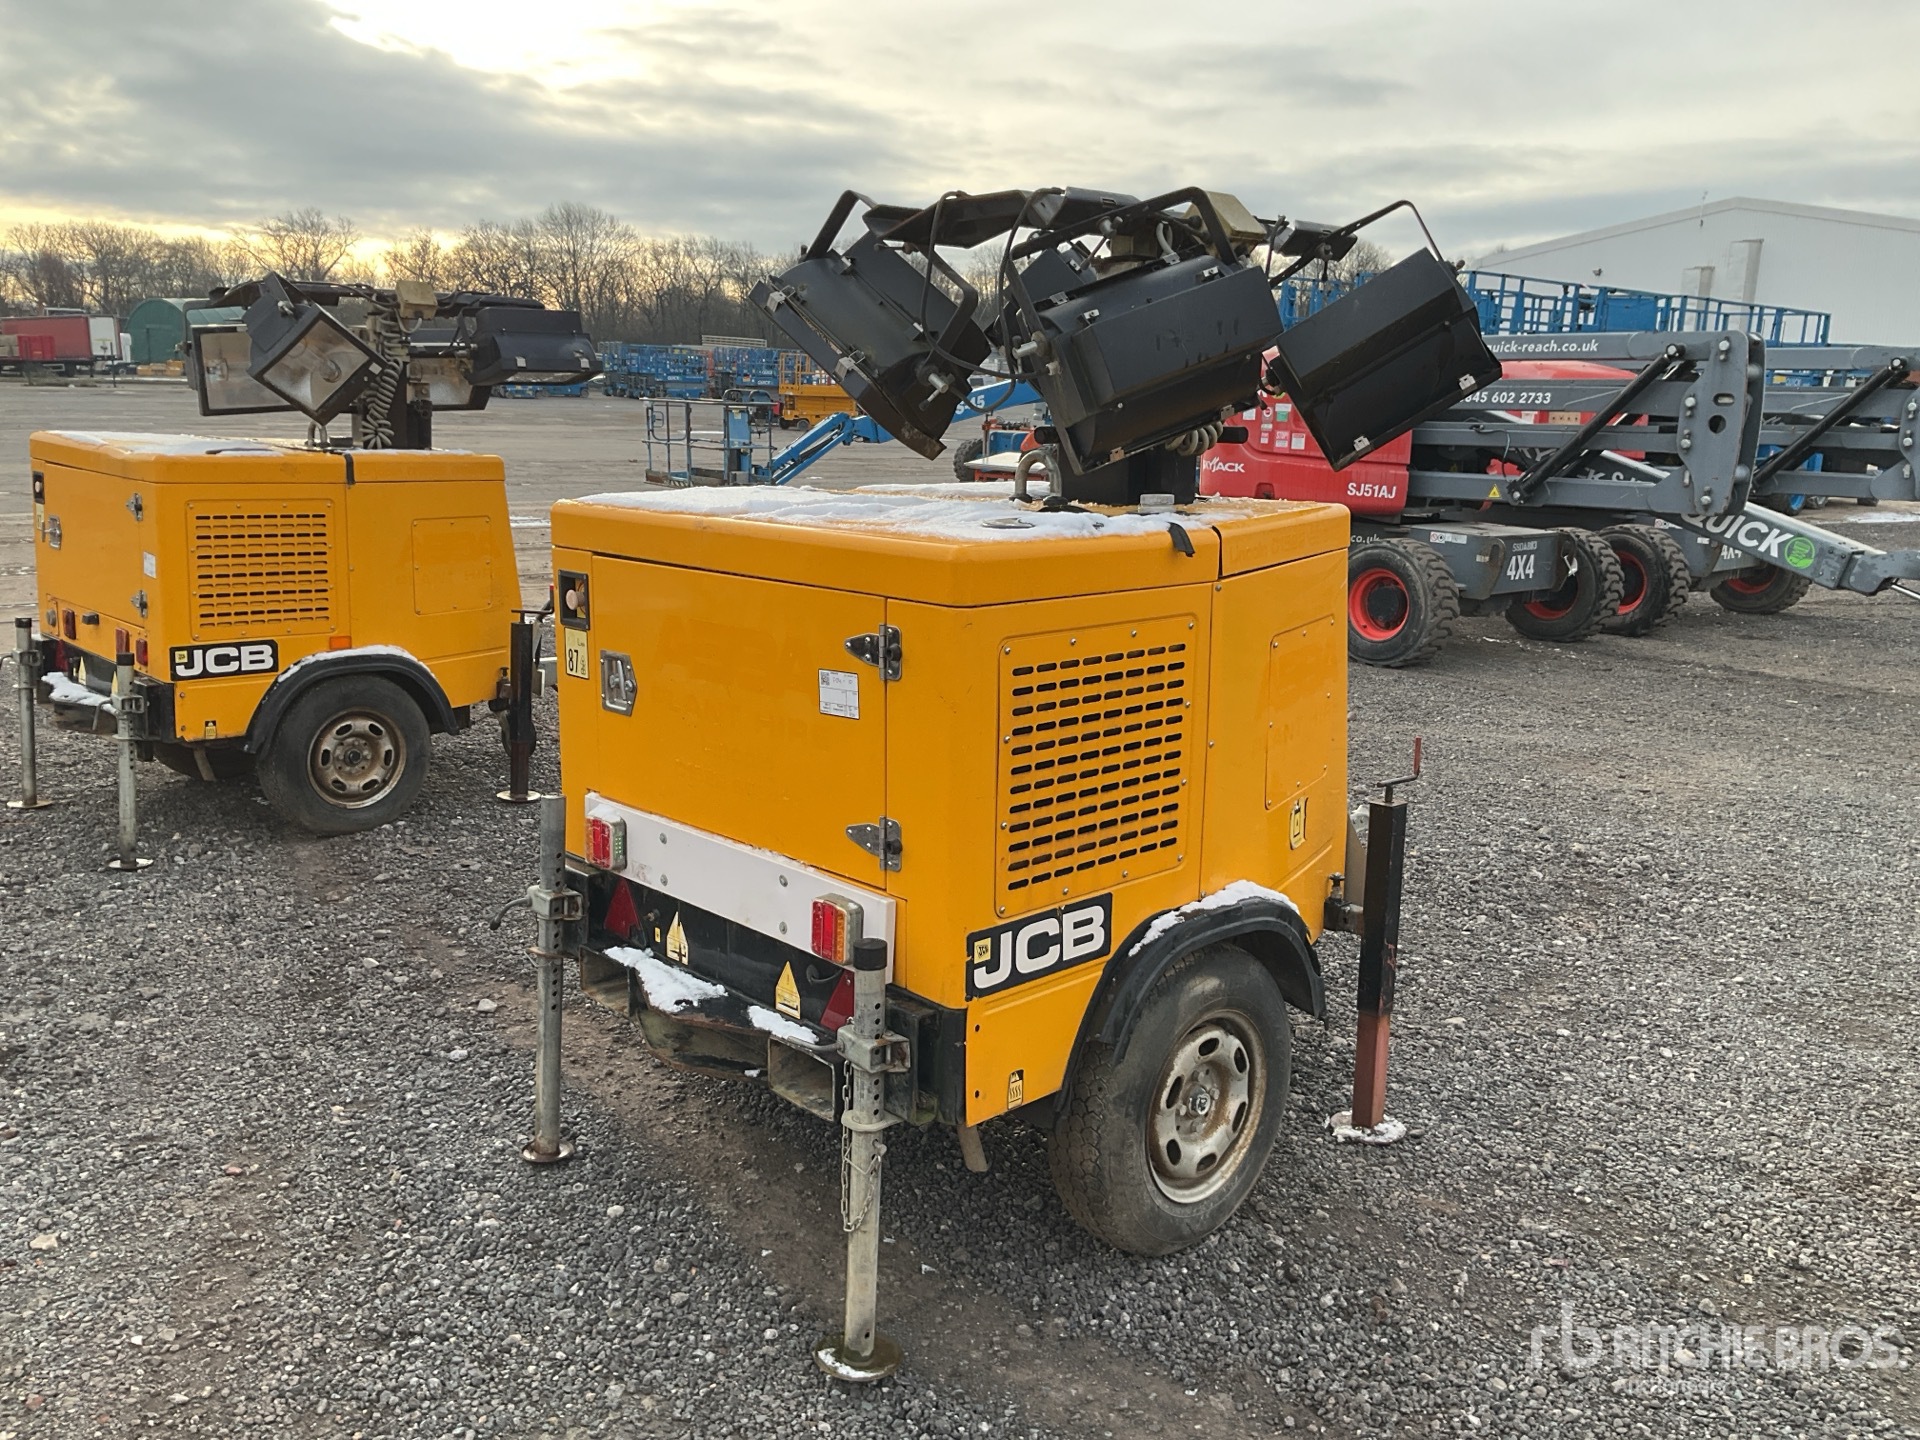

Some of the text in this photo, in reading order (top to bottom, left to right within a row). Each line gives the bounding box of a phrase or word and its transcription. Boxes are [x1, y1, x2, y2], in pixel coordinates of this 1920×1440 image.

[1460, 391, 1552, 404] 845 602 2733
[1347, 482, 1397, 499] SJ51AJ
[1506, 554, 1535, 580] 4X4
[175, 644, 274, 677] JCB
[568, 648, 579, 673] 87
[973, 905, 1105, 989] JCB
